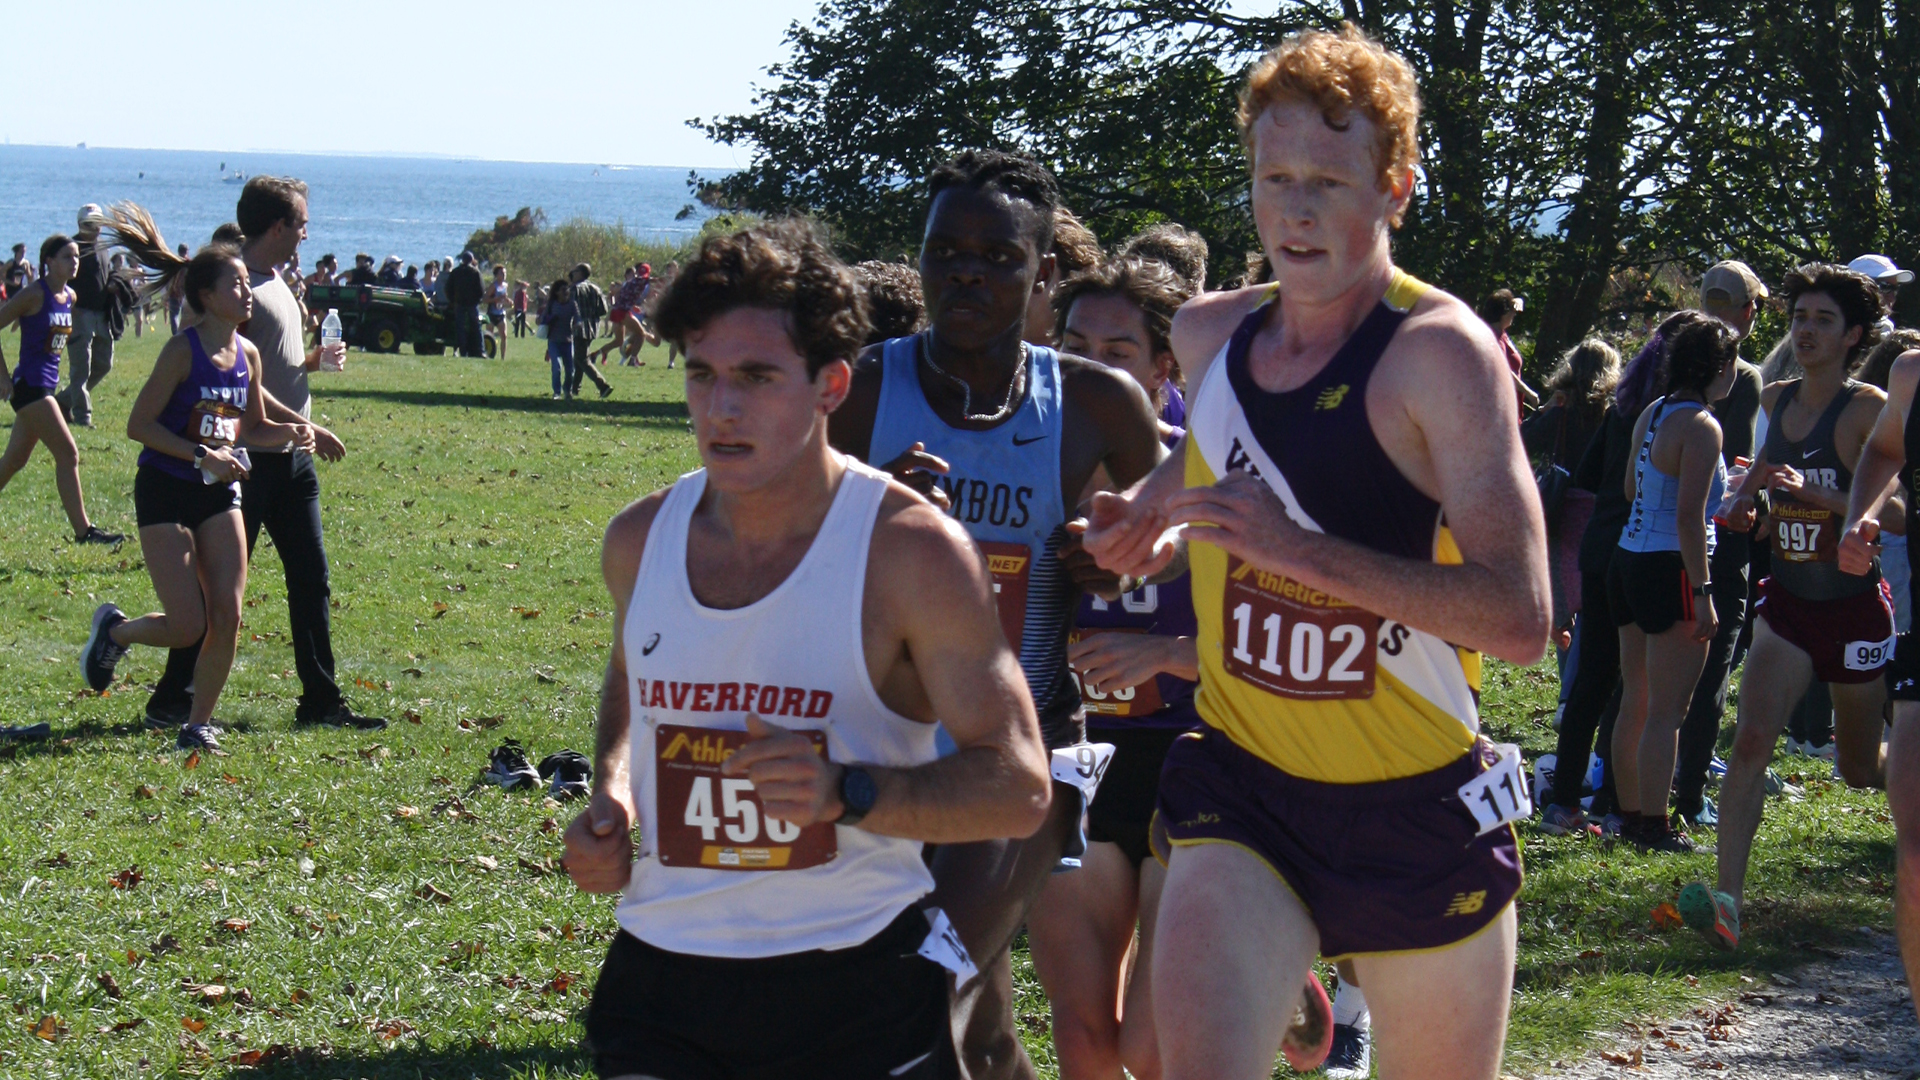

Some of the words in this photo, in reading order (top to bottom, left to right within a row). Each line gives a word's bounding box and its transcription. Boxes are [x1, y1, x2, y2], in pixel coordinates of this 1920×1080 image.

[931, 475, 1033, 528] MBOS
[1778, 521, 1821, 552] 997
[991, 559, 1021, 571] NET
[1232, 602, 1367, 682] 1102
[1857, 641, 1890, 665] 997
[637, 678, 834, 719] HAVERFORD
[660, 732, 745, 763] Athle
